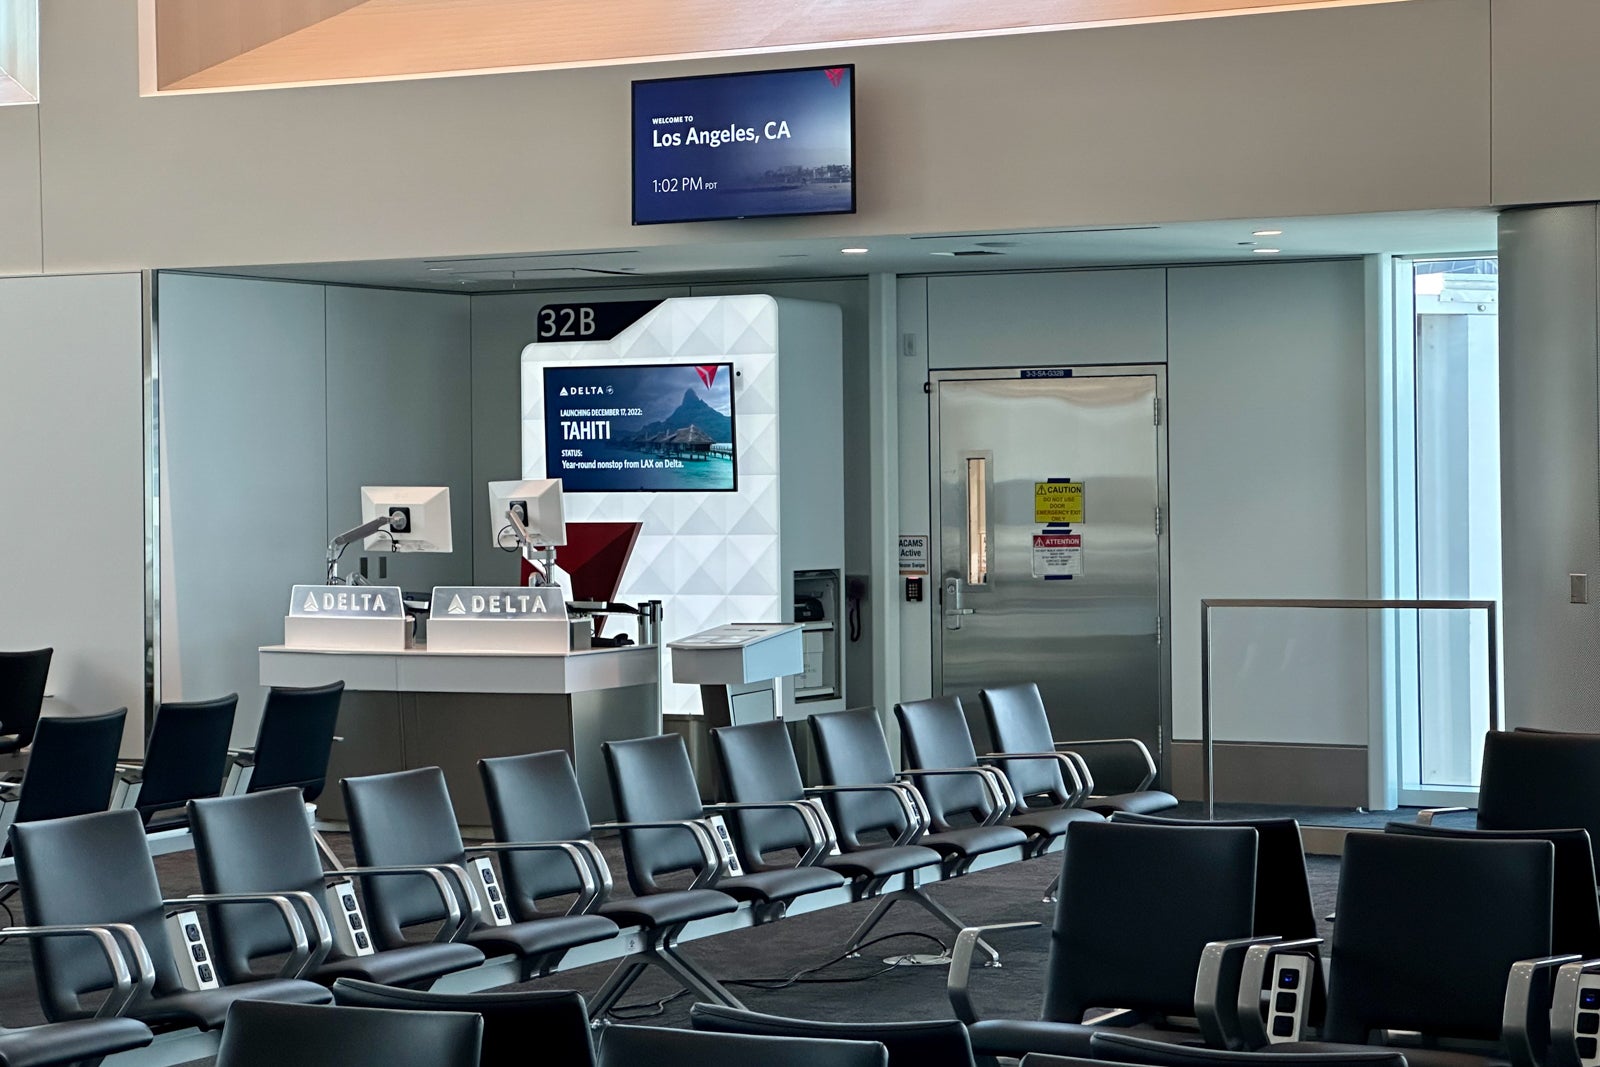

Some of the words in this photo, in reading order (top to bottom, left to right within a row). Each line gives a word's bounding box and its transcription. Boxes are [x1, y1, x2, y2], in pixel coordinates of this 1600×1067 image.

[652, 116, 683, 124] WELCOME
[652, 129, 681, 147] Los
[685, 123, 759, 147] Angeles,
[764, 120, 791, 140] CA
[652, 178, 678, 192] 1:02
[682, 177, 702, 191] PM
[705, 182, 717, 190] PDT
[540, 307, 596, 337] 32B
[570, 386, 604, 395] DELTA
[560, 409, 590, 417] LAUNCHING
[591, 408, 619, 416] DECEMBER
[627, 408, 643, 416] 2022:
[560, 421, 610, 440] TAHITI
[561, 449, 583, 457] STATUS:
[561, 460, 596, 469] Year-round
[597, 460, 623, 470] nonstop
[624, 459, 639, 468] from
[640, 459, 654, 468] LAX
[664, 459, 684, 468] Delta.
[1047, 486, 1081, 494] CAUTION
[899, 539, 923, 547] ACAMS
[900, 549, 921, 557] Active
[322, 594, 386, 612] DELTA
[471, 594, 547, 613] DELTA
